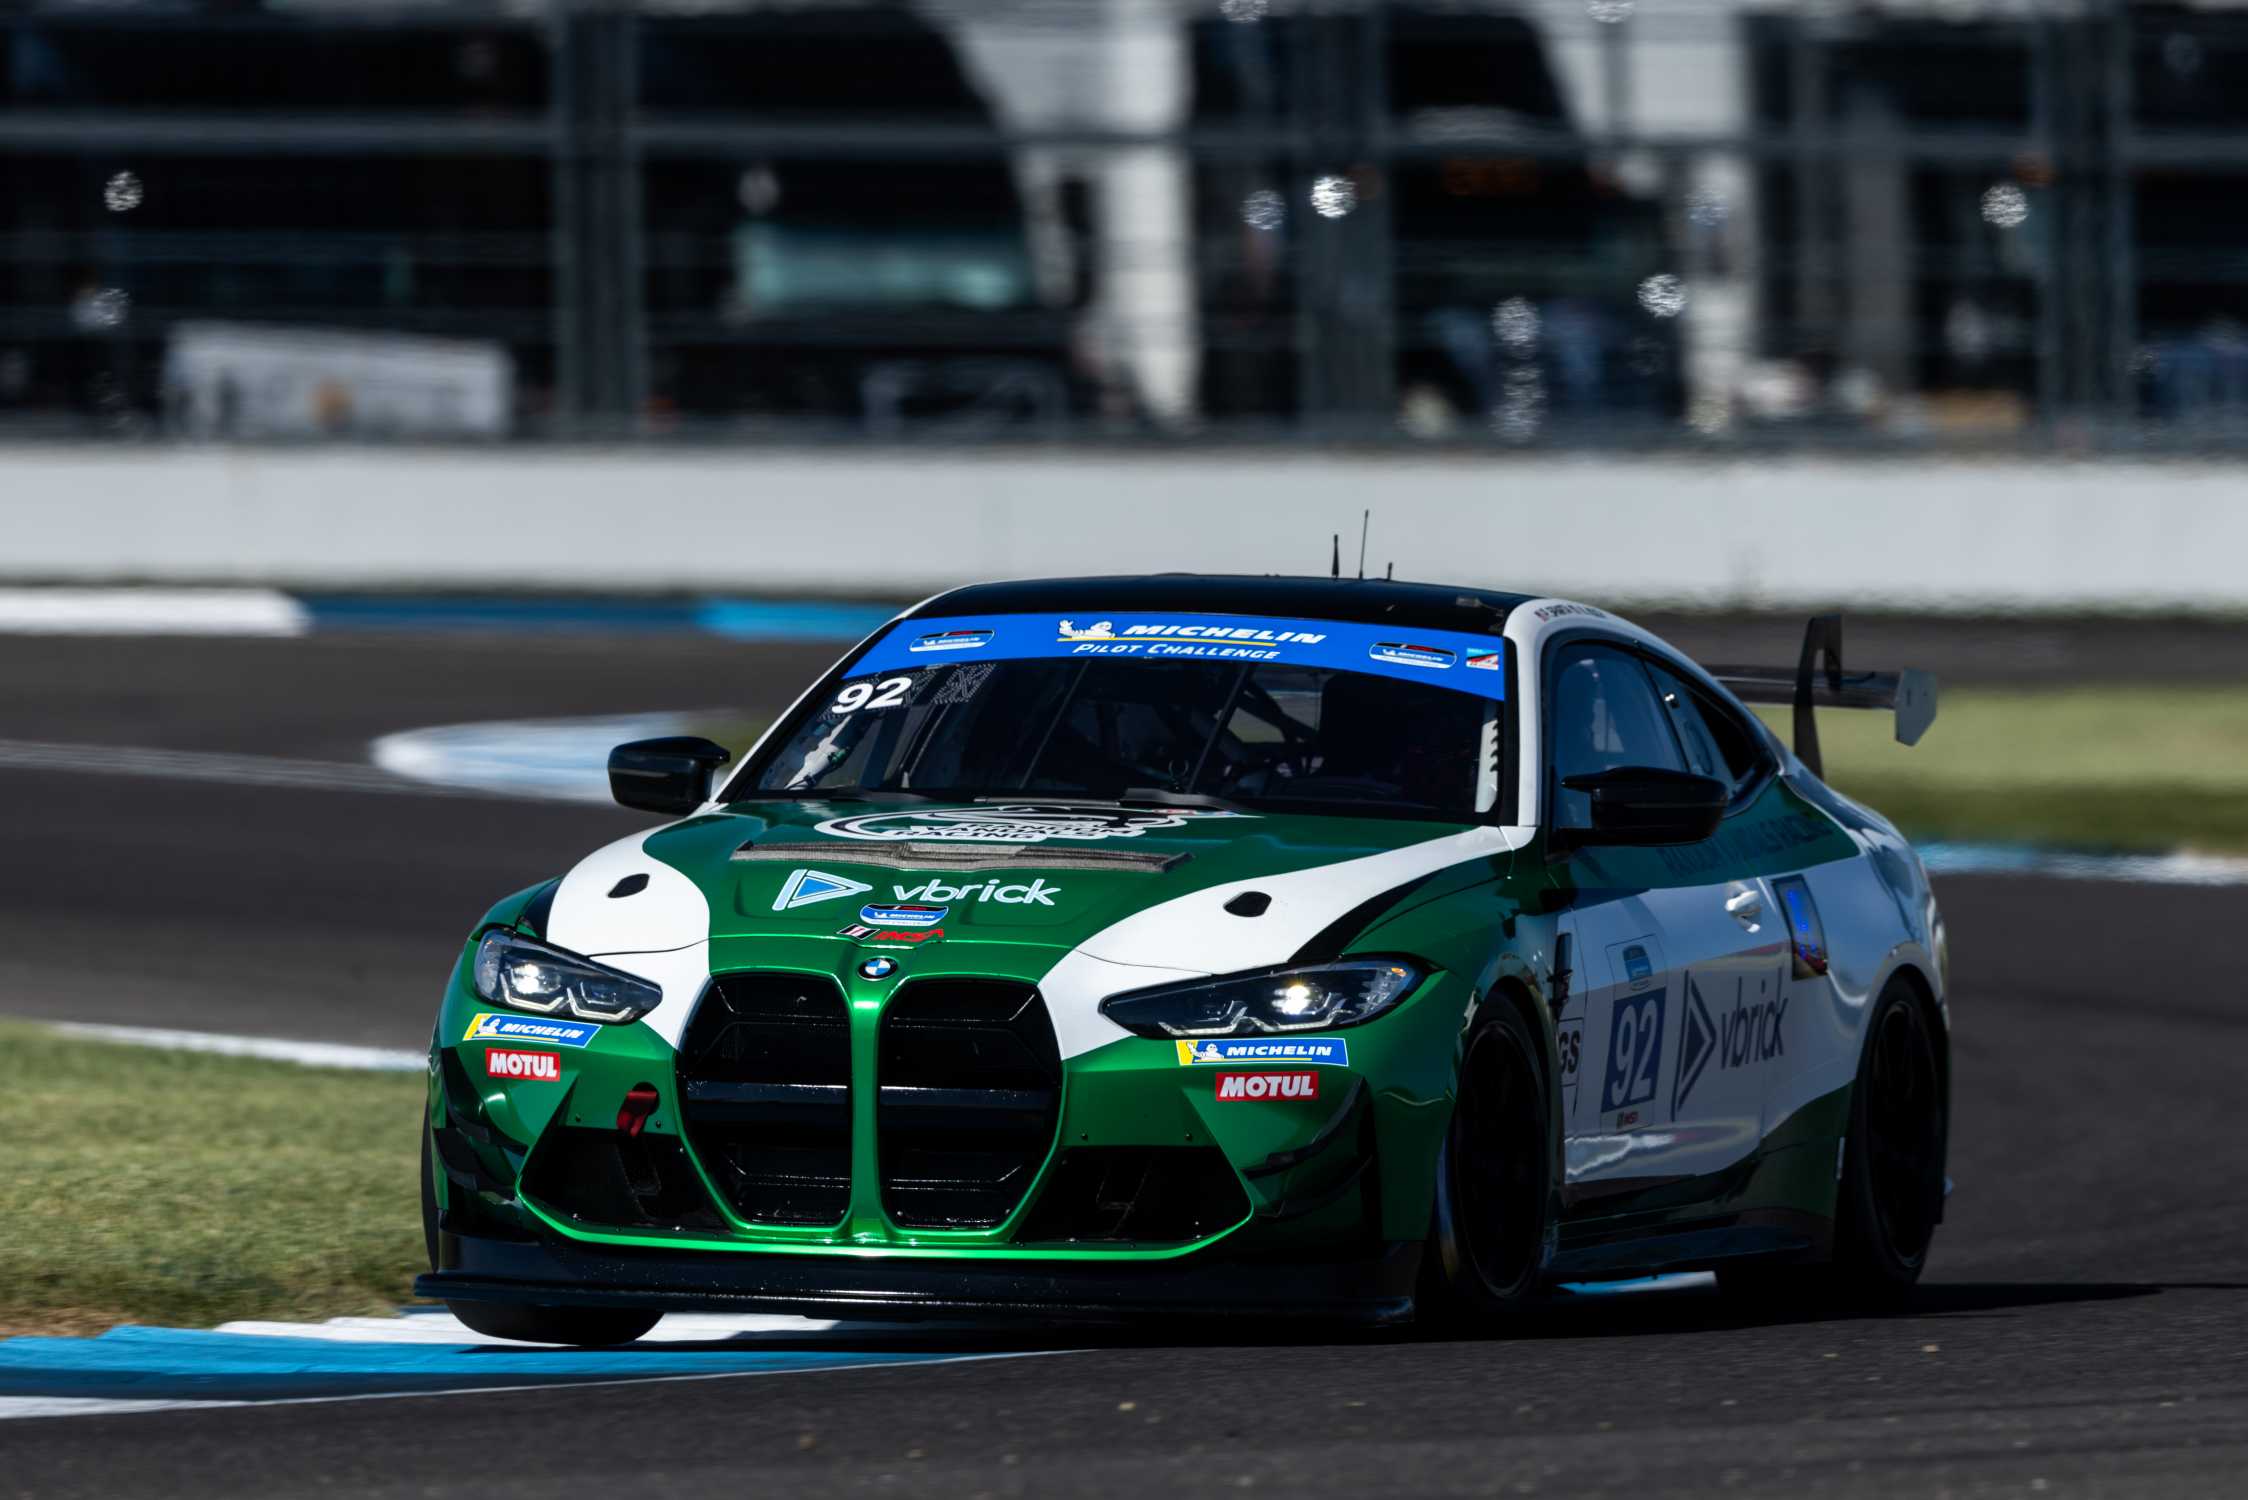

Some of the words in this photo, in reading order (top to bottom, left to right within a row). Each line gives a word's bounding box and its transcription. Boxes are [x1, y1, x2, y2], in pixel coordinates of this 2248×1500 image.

[1123, 625, 1327, 644] MICHELIN
[1072, 643, 1144, 654] PILOT
[1148, 643, 1280, 660] CHALLENGE
[832, 677, 912, 714] 92
[893, 830, 1034, 840] RACING
[893, 879, 1061, 905] vbrick
[1718, 966, 1789, 1070] vbrick
[500, 1022, 585, 1040] MICHELIN
[1226, 1045, 1333, 1057] MICHELIN
[1559, 1030, 1581, 1075] GS
[1611, 998, 1659, 1106] 92
[489, 1052, 558, 1078] MOTUL
[1219, 1074, 1314, 1098] MOTUL
